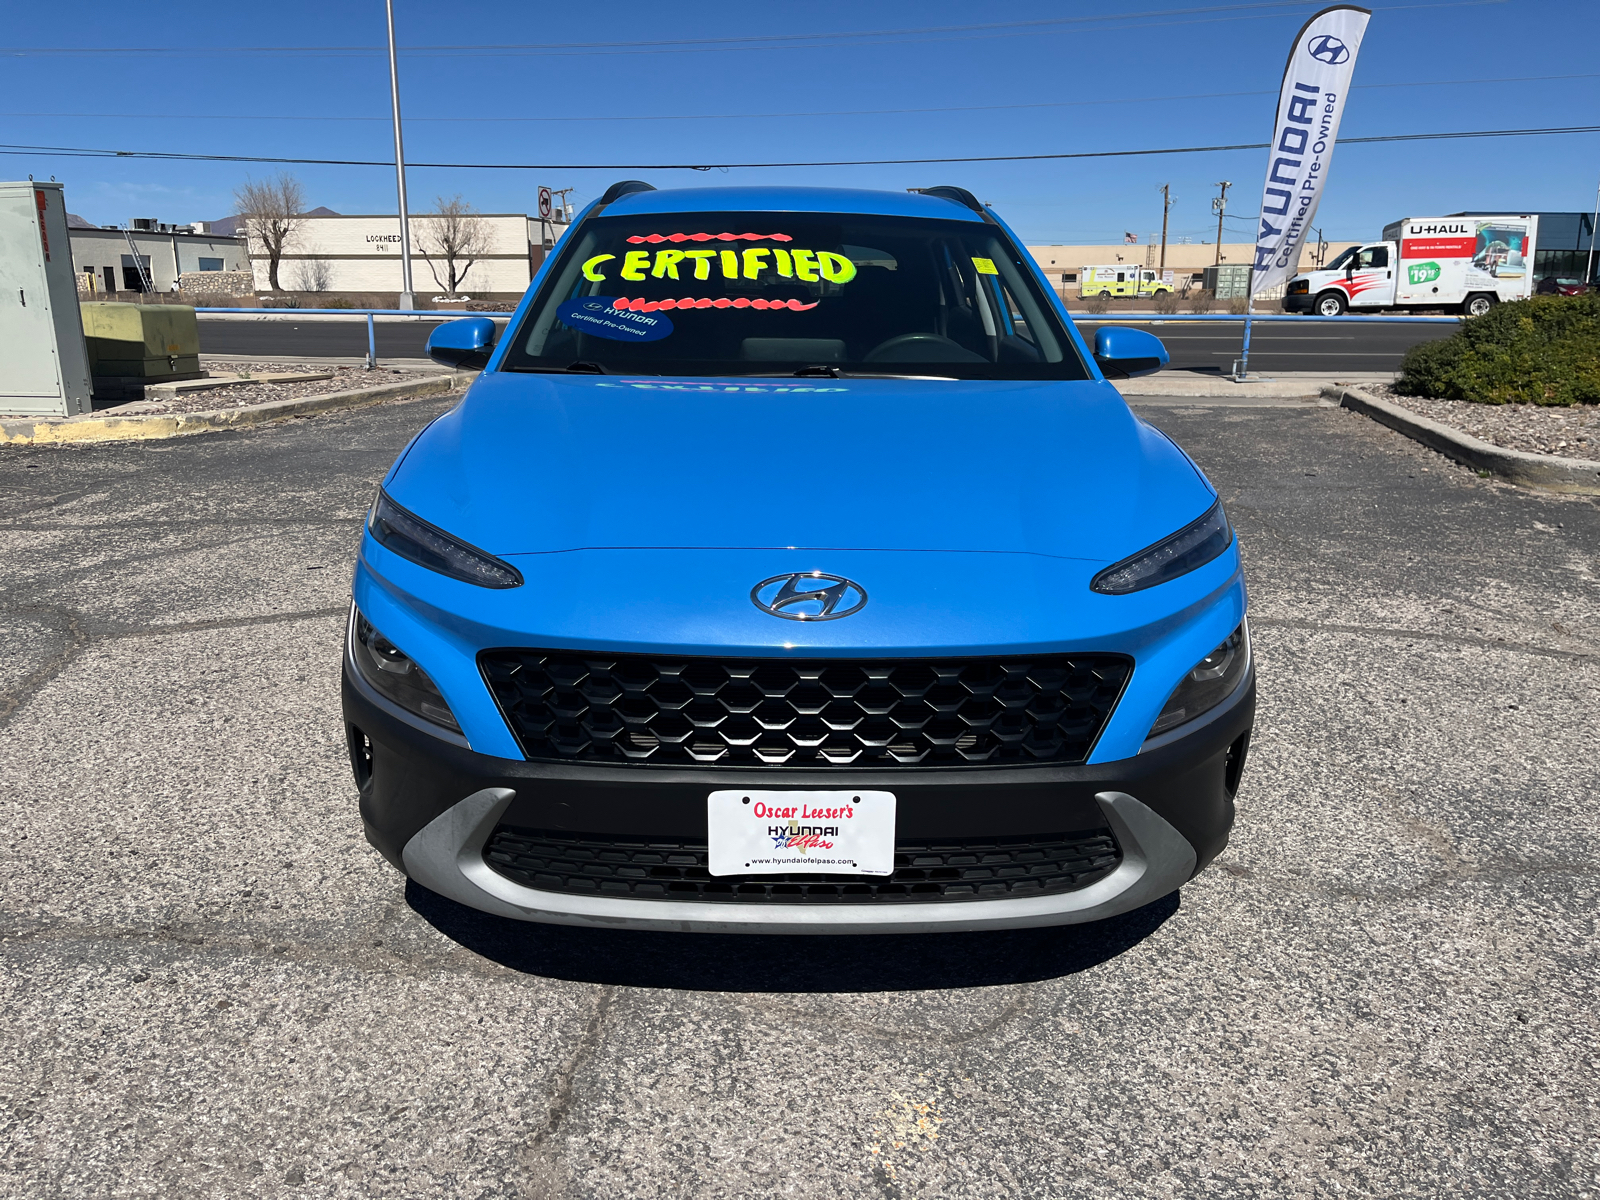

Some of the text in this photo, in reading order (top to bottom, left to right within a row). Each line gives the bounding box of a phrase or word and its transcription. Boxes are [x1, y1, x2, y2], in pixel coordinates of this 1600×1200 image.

[1253, 82, 1321, 272] HYUNDAI
[1275, 92, 1337, 269] Certified Pre-Owned
[1410, 225, 1468, 234] U-HAUL
[376, 244, 389, 252] 8411
[582, 247, 857, 284] CERTIFIED
[571, 312, 647, 336] Certified Pre-Owned
[603, 307, 658, 327] HYUNDAI
[754, 802, 854, 819] Oscar Leeser's
[768, 826, 839, 837] HYUNDAI
[776, 836, 789, 850] of
[751, 857, 854, 865] www.hyundaiofelpaso.com
